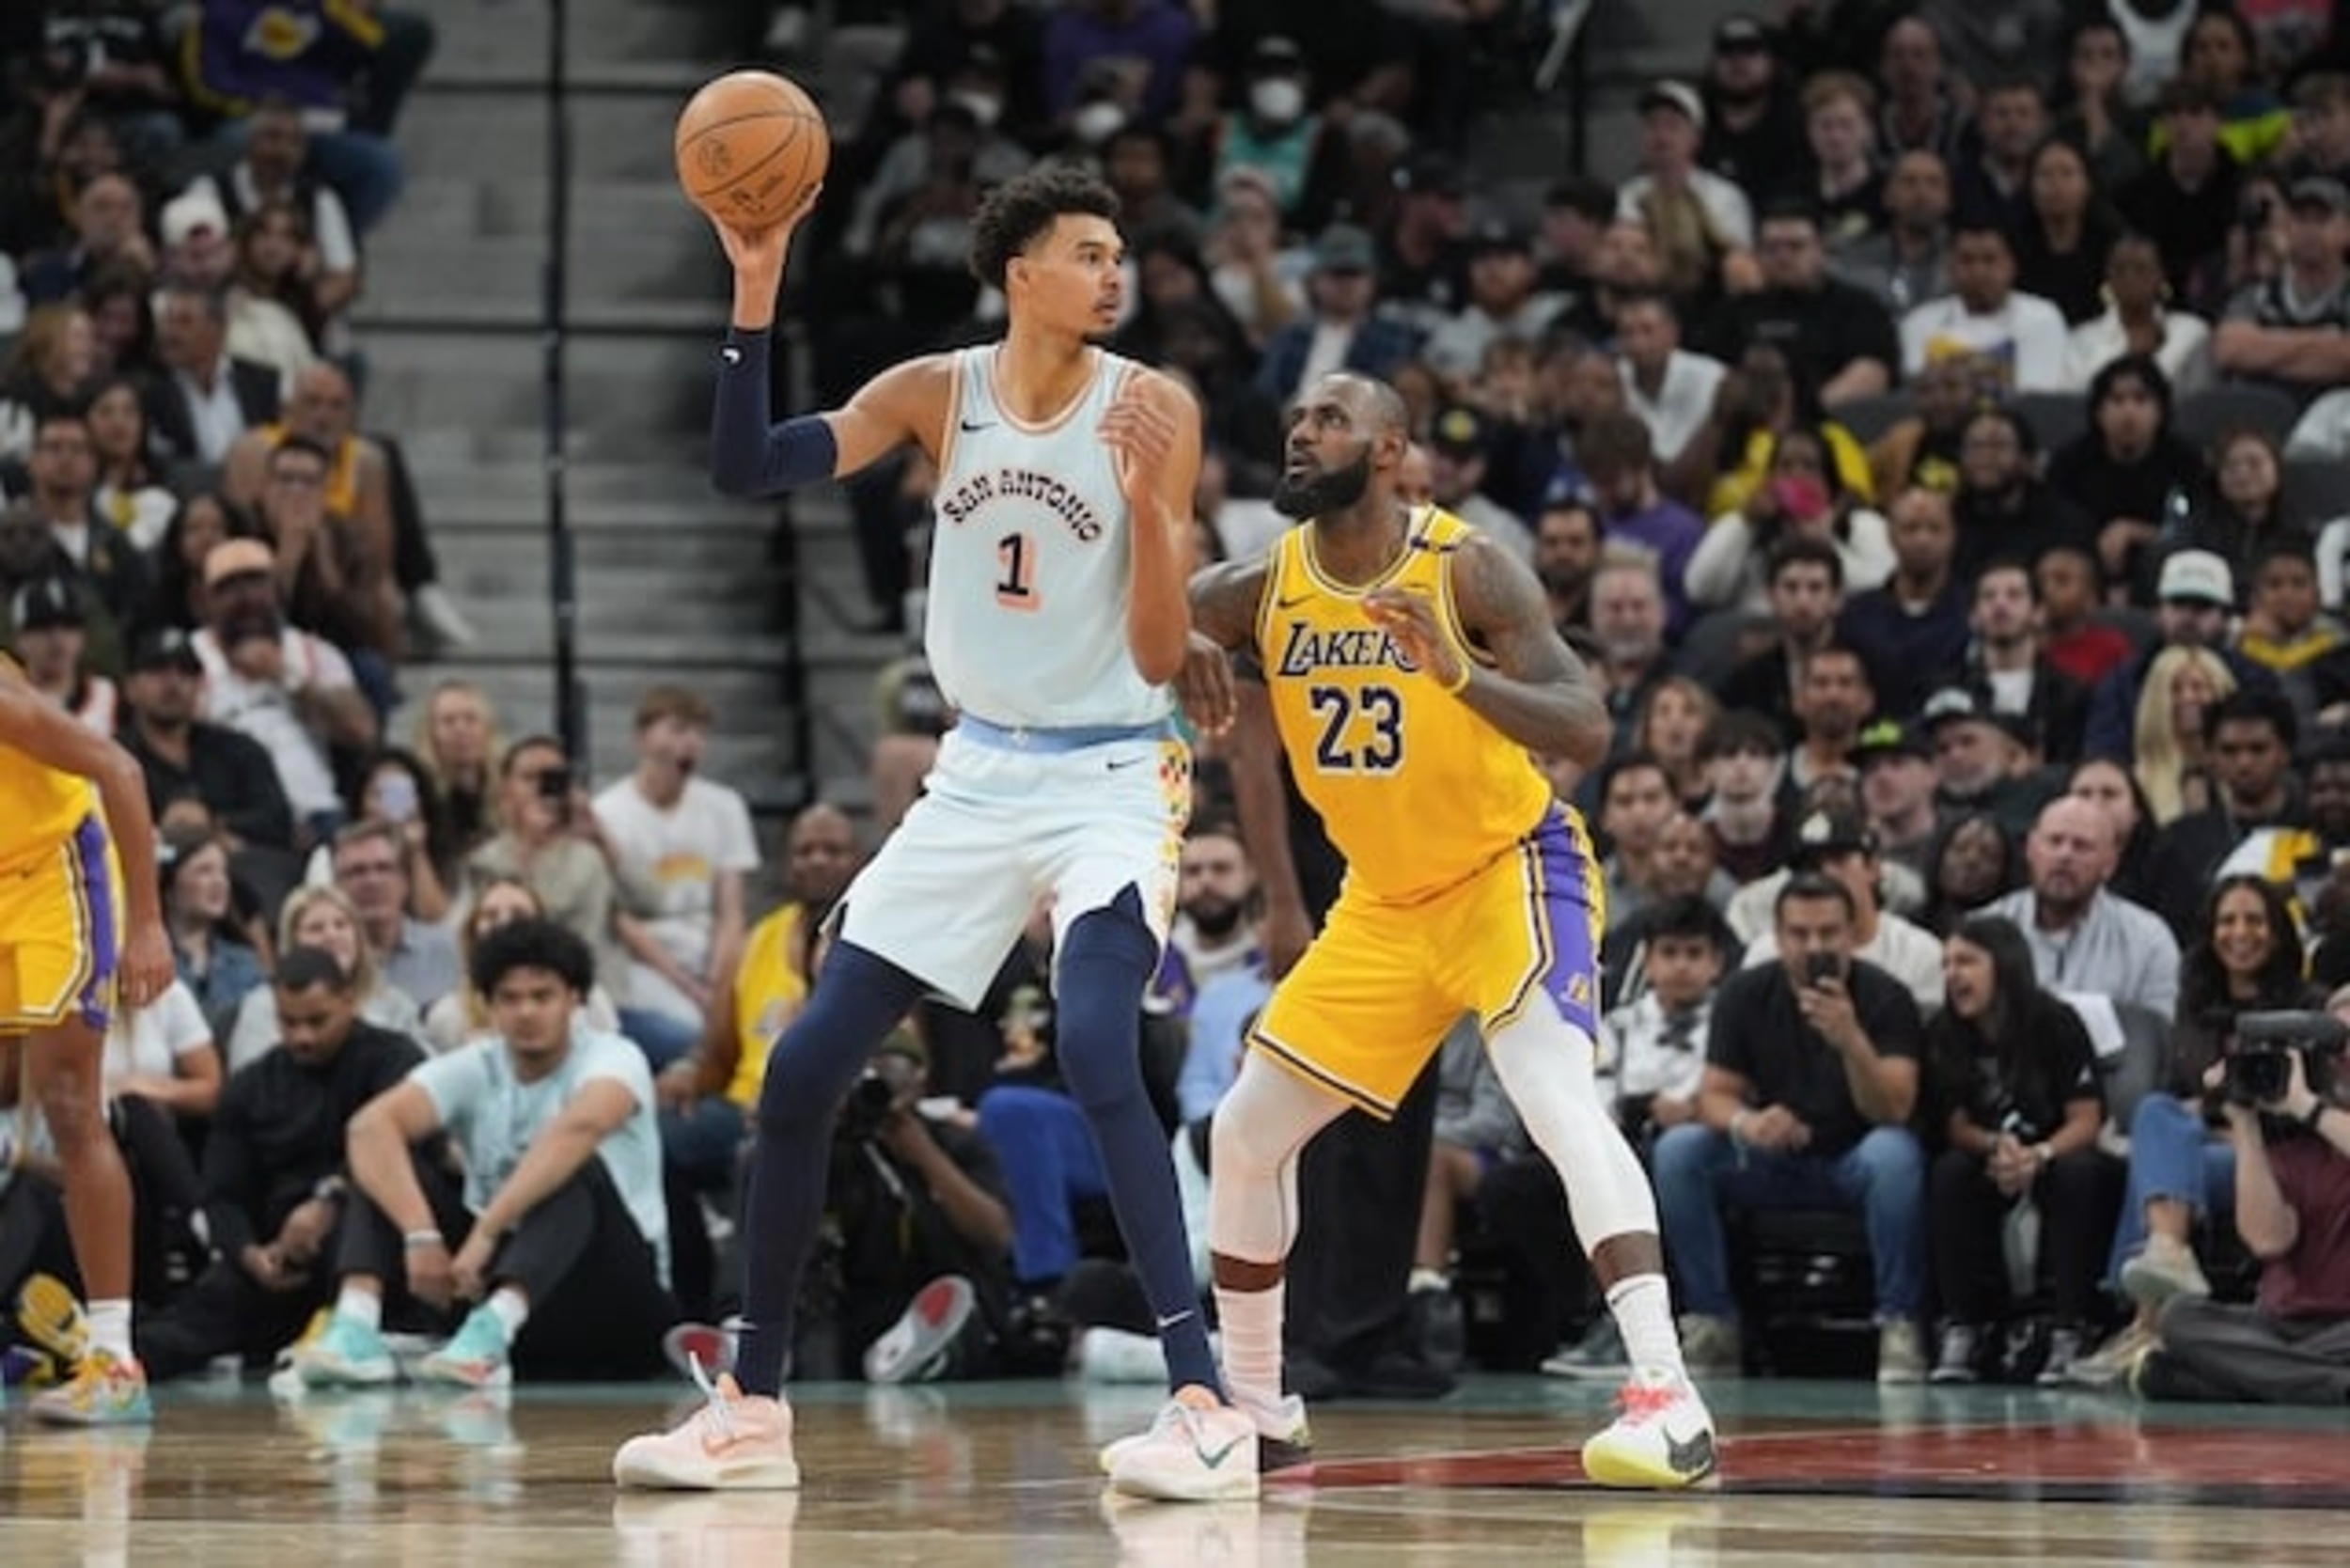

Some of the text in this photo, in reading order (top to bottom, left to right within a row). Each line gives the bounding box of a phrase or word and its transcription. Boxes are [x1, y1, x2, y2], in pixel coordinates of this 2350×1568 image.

[942, 468, 1103, 542] SAN ANTONIO
[996, 530, 1037, 604] 1
[1308, 683, 1404, 775] 23
